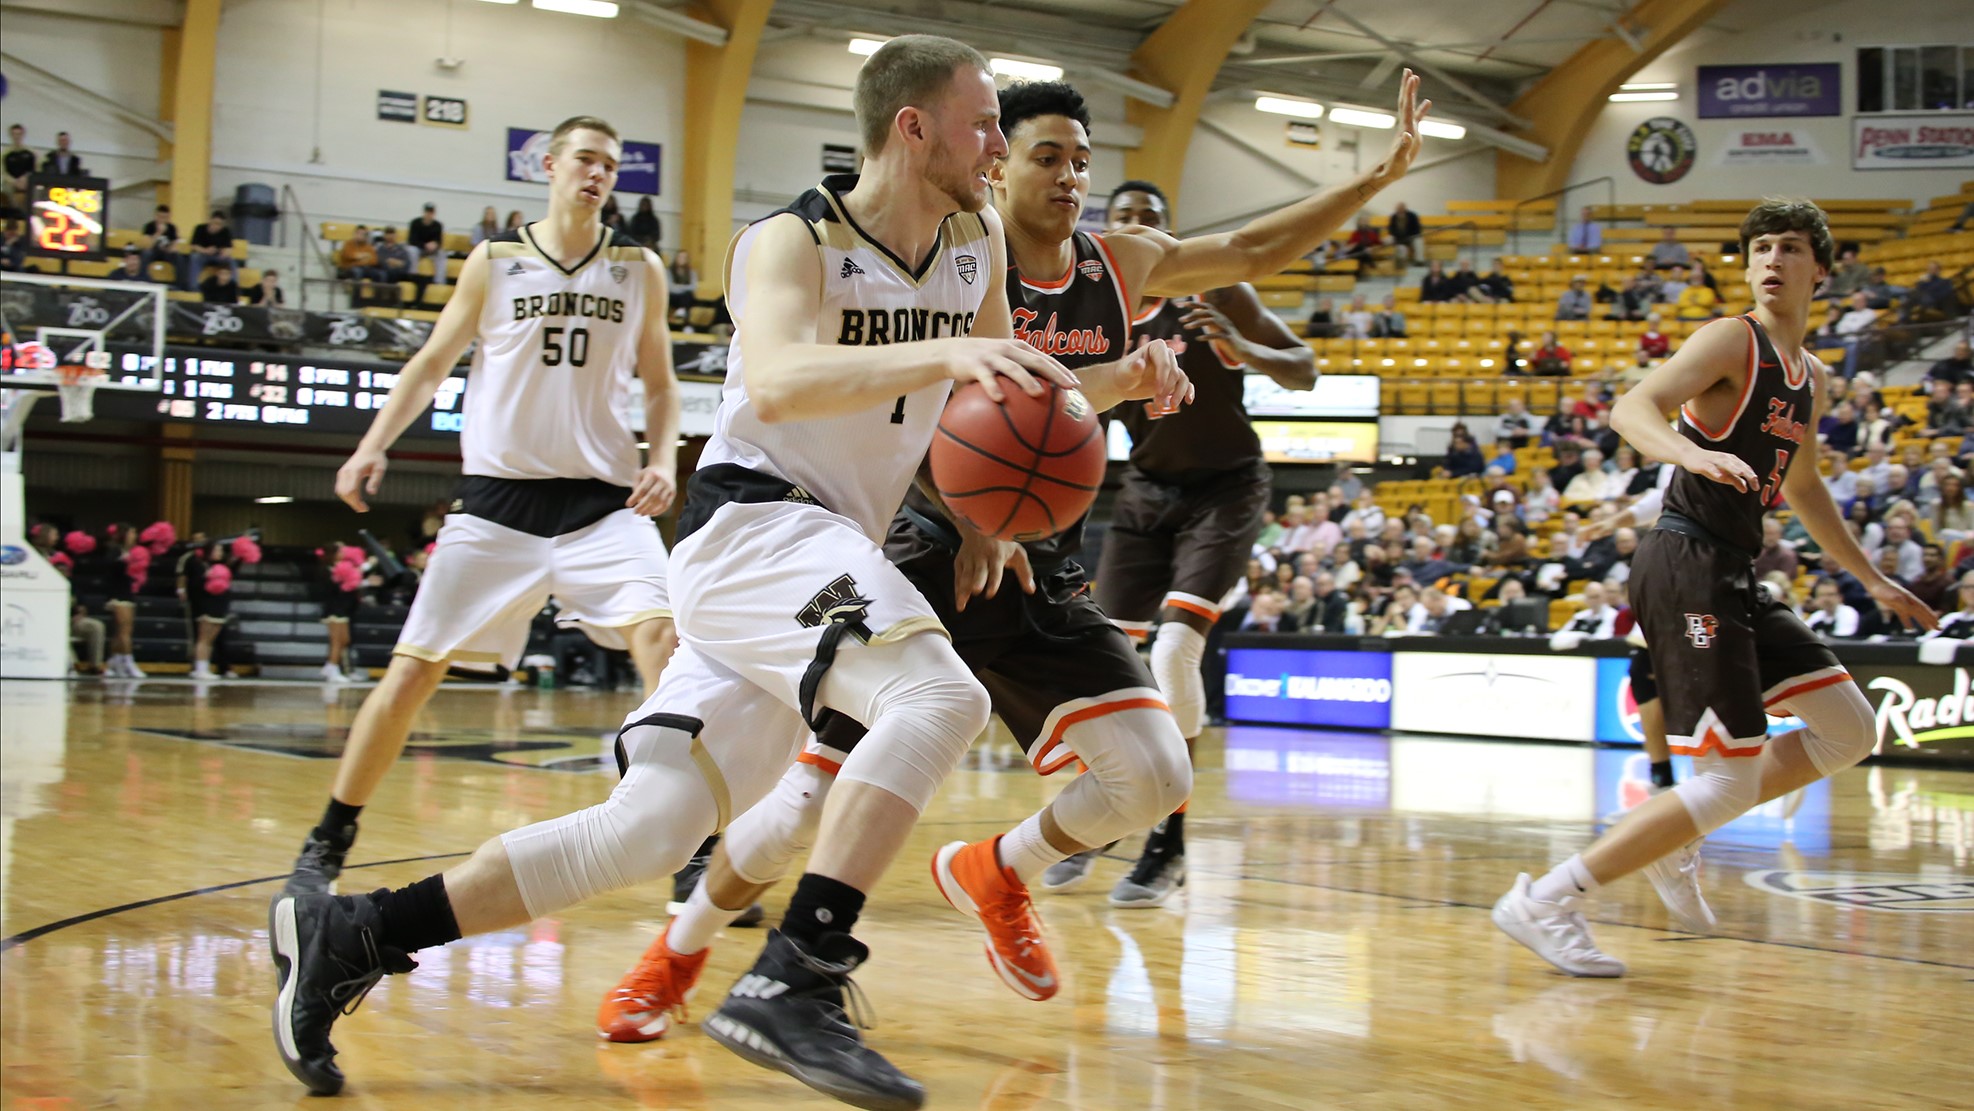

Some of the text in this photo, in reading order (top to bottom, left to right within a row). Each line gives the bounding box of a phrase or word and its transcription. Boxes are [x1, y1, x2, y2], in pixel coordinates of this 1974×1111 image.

[1715, 70, 1821, 100] advia
[1741, 132, 1795, 147] EMA
[1858, 126, 1911, 159] PENN
[39, 209, 89, 252] 22
[513, 292, 625, 323] BRONCOS
[837, 308, 975, 346] BRONCOS
[1012, 306, 1110, 356] Falcons
[541, 327, 590, 368] 50
[206, 401, 223, 421] 2
[1760, 449, 1788, 506] 5
